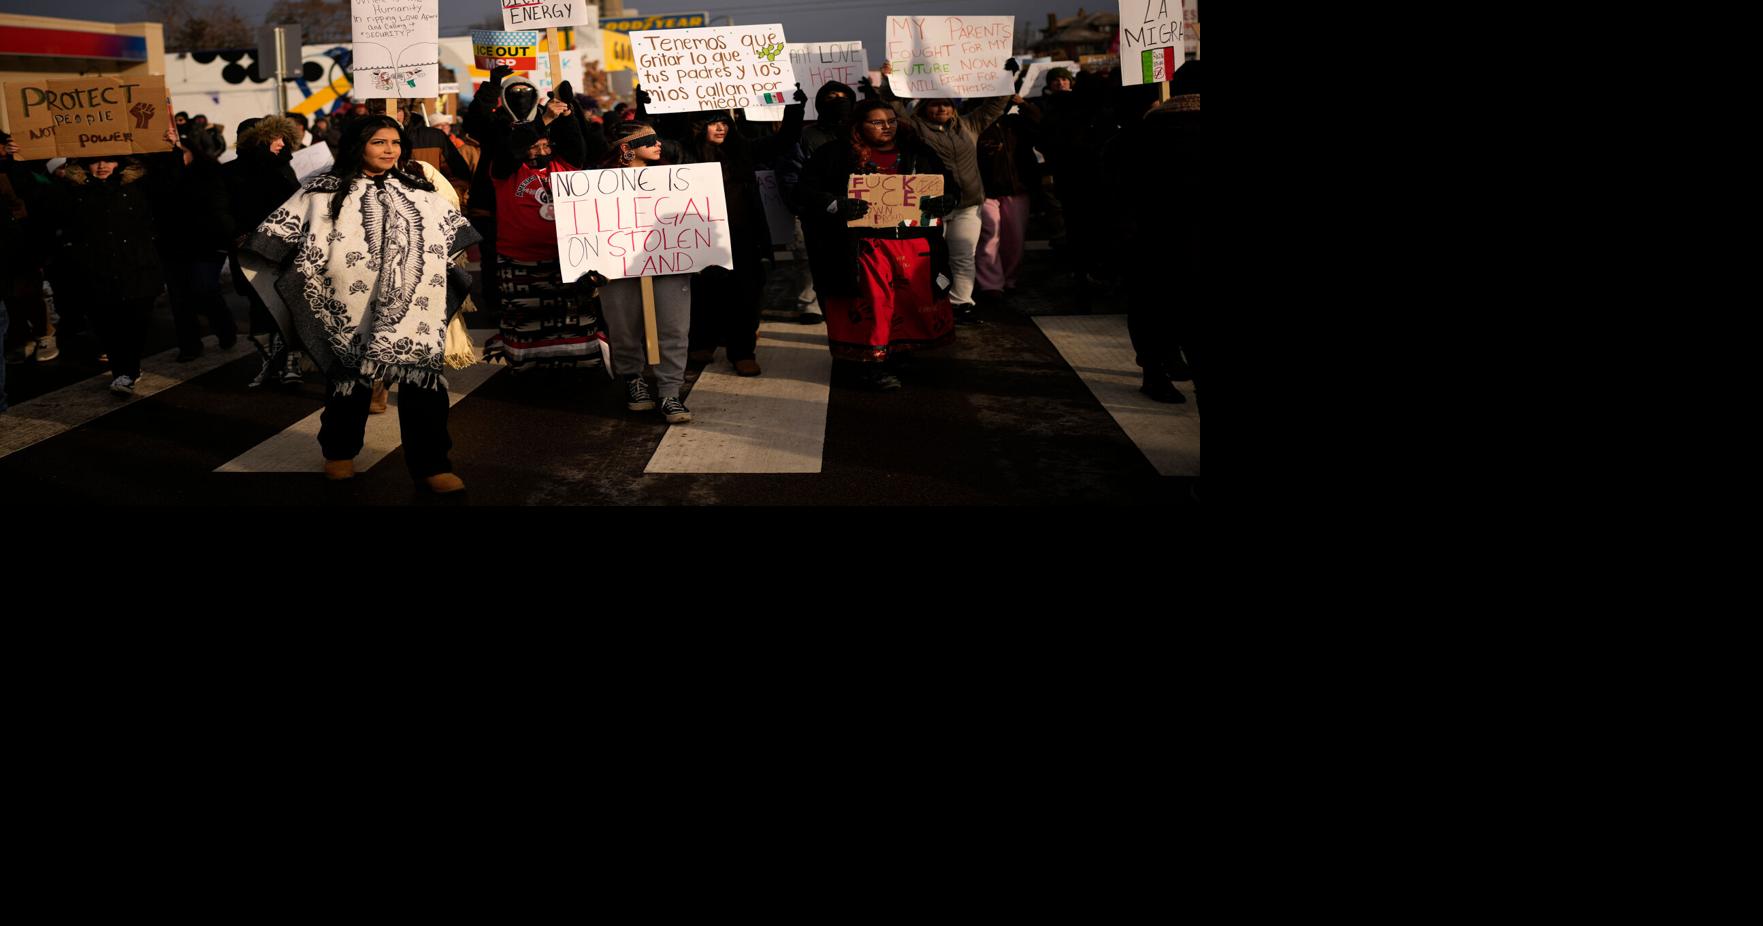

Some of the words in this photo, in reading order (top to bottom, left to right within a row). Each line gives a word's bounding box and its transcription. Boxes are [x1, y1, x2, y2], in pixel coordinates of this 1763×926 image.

[372, 4, 422, 14] Humanity
[510, 3, 572, 25] ENERGY
[1143, 0, 1168, 24] LA
[604, 16, 702, 31] OODYEAR
[892, 16, 925, 40] MY
[944, 16, 1011, 41] PARENTS
[476, 46, 494, 56] ICE
[495, 46, 530, 56] OUT
[643, 35, 727, 52] Tenemos
[741, 32, 778, 55] que
[819, 43, 863, 63] LOVE
[888, 41, 956, 59] FOUGHT
[961, 42, 982, 54] FOR
[988, 39, 1008, 51] MY
[640, 53, 685, 68] Gritar
[690, 52, 707, 65] lo
[712, 50, 742, 68] que
[891, 60, 950, 77] FUTURE
[960, 56, 999, 71] NOW
[644, 70, 669, 84] tus
[736, 65, 746, 80] y
[753, 62, 781, 77] los
[809, 65, 859, 88] HATE
[907, 79, 939, 93] WILL
[977, 72, 998, 81] FOR
[752, 81, 782, 96] por
[21, 83, 140, 118] PROTECT
[30, 125, 57, 141] NOT
[556, 171, 590, 197] NO
[597, 168, 655, 195] ONE
[668, 167, 692, 192] IS
[852, 175, 916, 193] FUCK
[560, 196, 725, 236] ILLEGAL
[568, 235, 599, 268] ON
[607, 227, 711, 257] STOLEN
[623, 251, 693, 277] LAND
